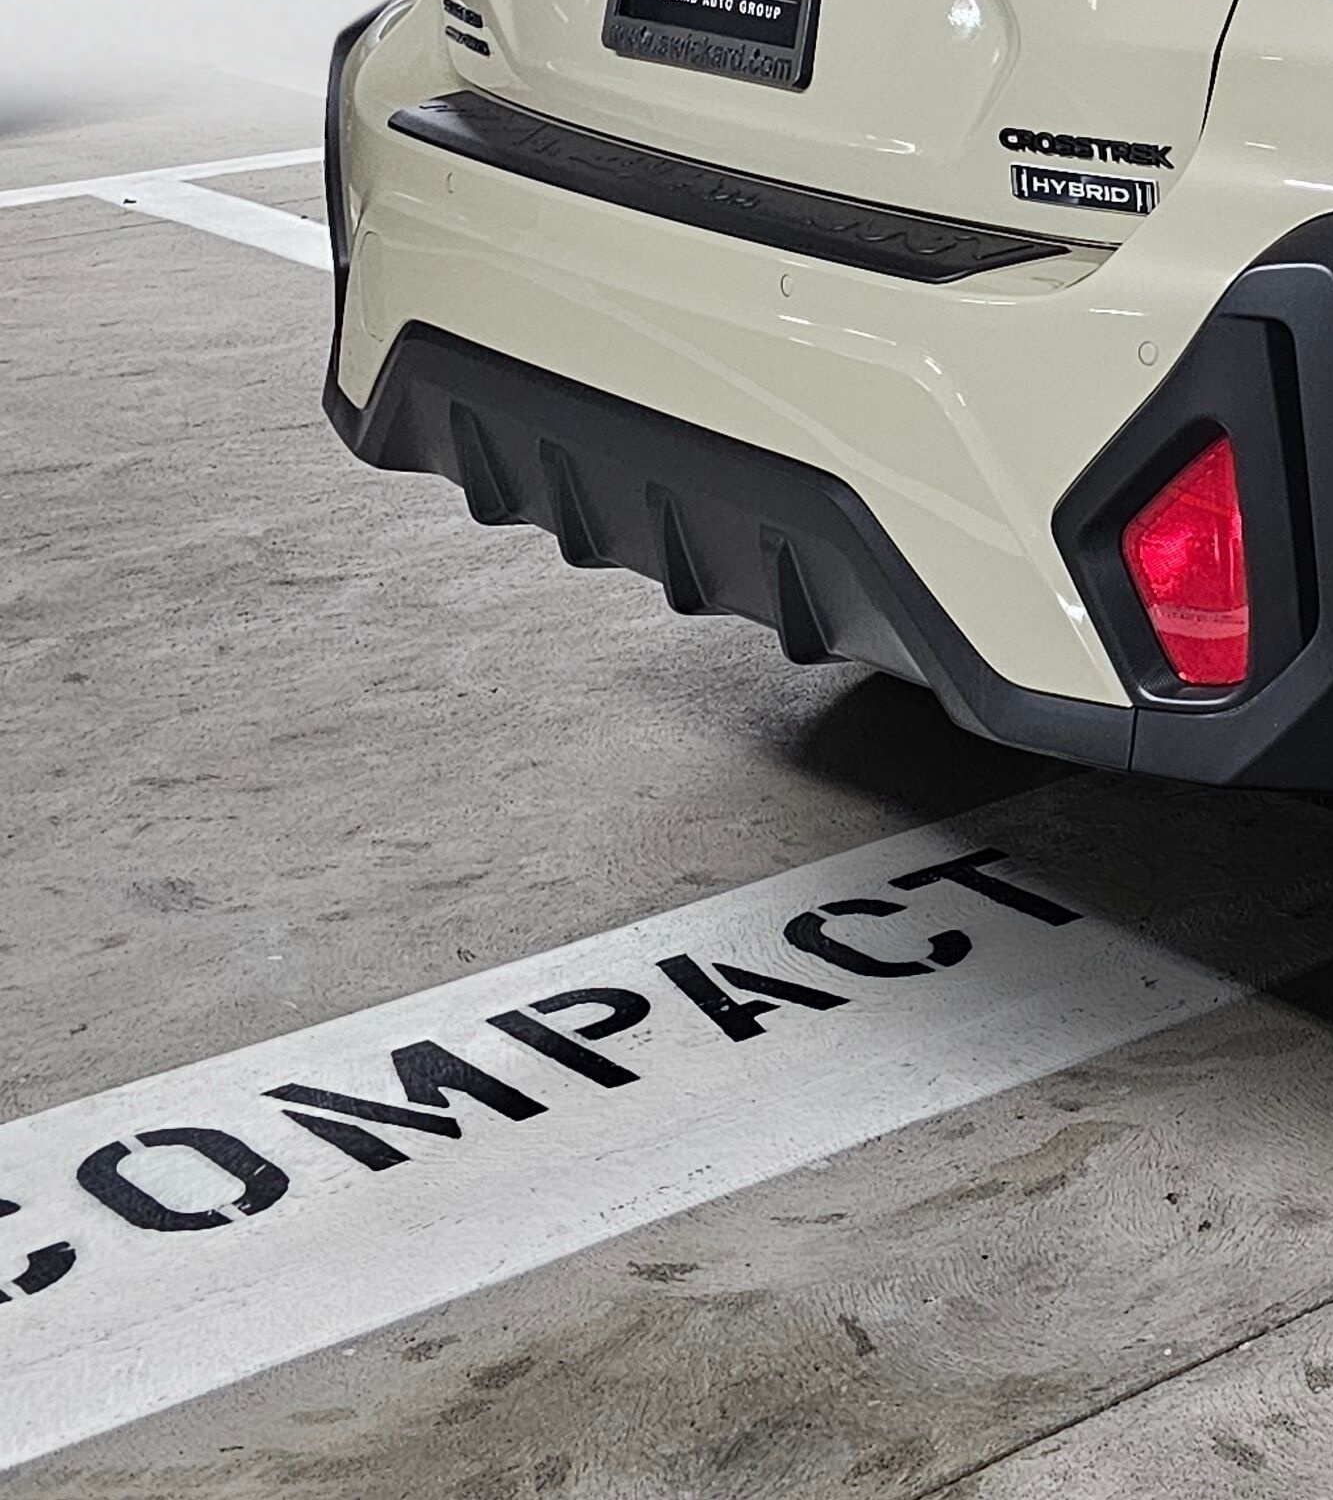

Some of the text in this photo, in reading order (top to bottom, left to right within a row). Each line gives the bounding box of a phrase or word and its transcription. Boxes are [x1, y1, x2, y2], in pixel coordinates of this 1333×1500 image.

[739, 0, 782, 20] GROUP
[998, 127, 1175, 169] CROSSTREK
[1032, 176, 1131, 204] HYBRID
